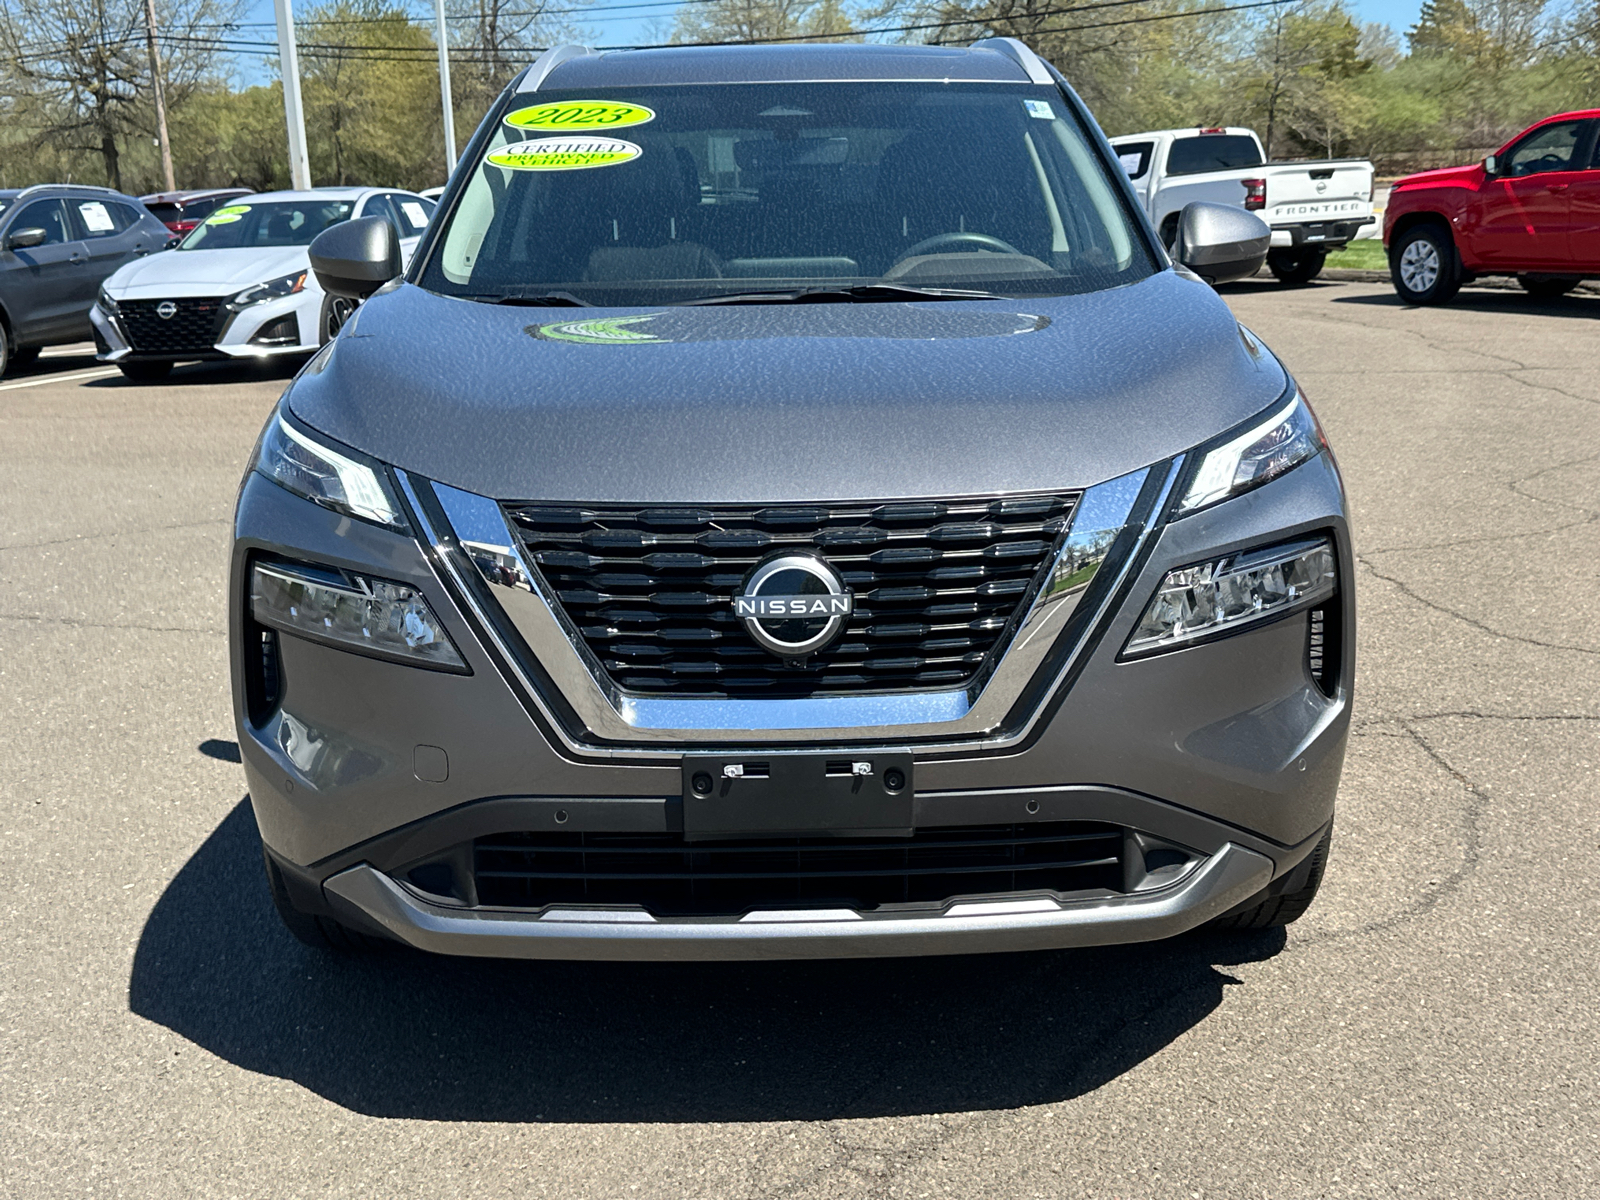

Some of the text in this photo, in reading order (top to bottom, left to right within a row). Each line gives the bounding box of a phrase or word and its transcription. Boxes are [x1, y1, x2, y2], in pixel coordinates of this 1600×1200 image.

[523, 108, 633, 125] 2023
[507, 143, 626, 155] CERTIFIED
[507, 153, 615, 161] PRE-OWNED
[520, 158, 595, 166] VEHICLE
[1275, 203, 1360, 215] FRONTIER
[738, 597, 848, 614] NISSAN
